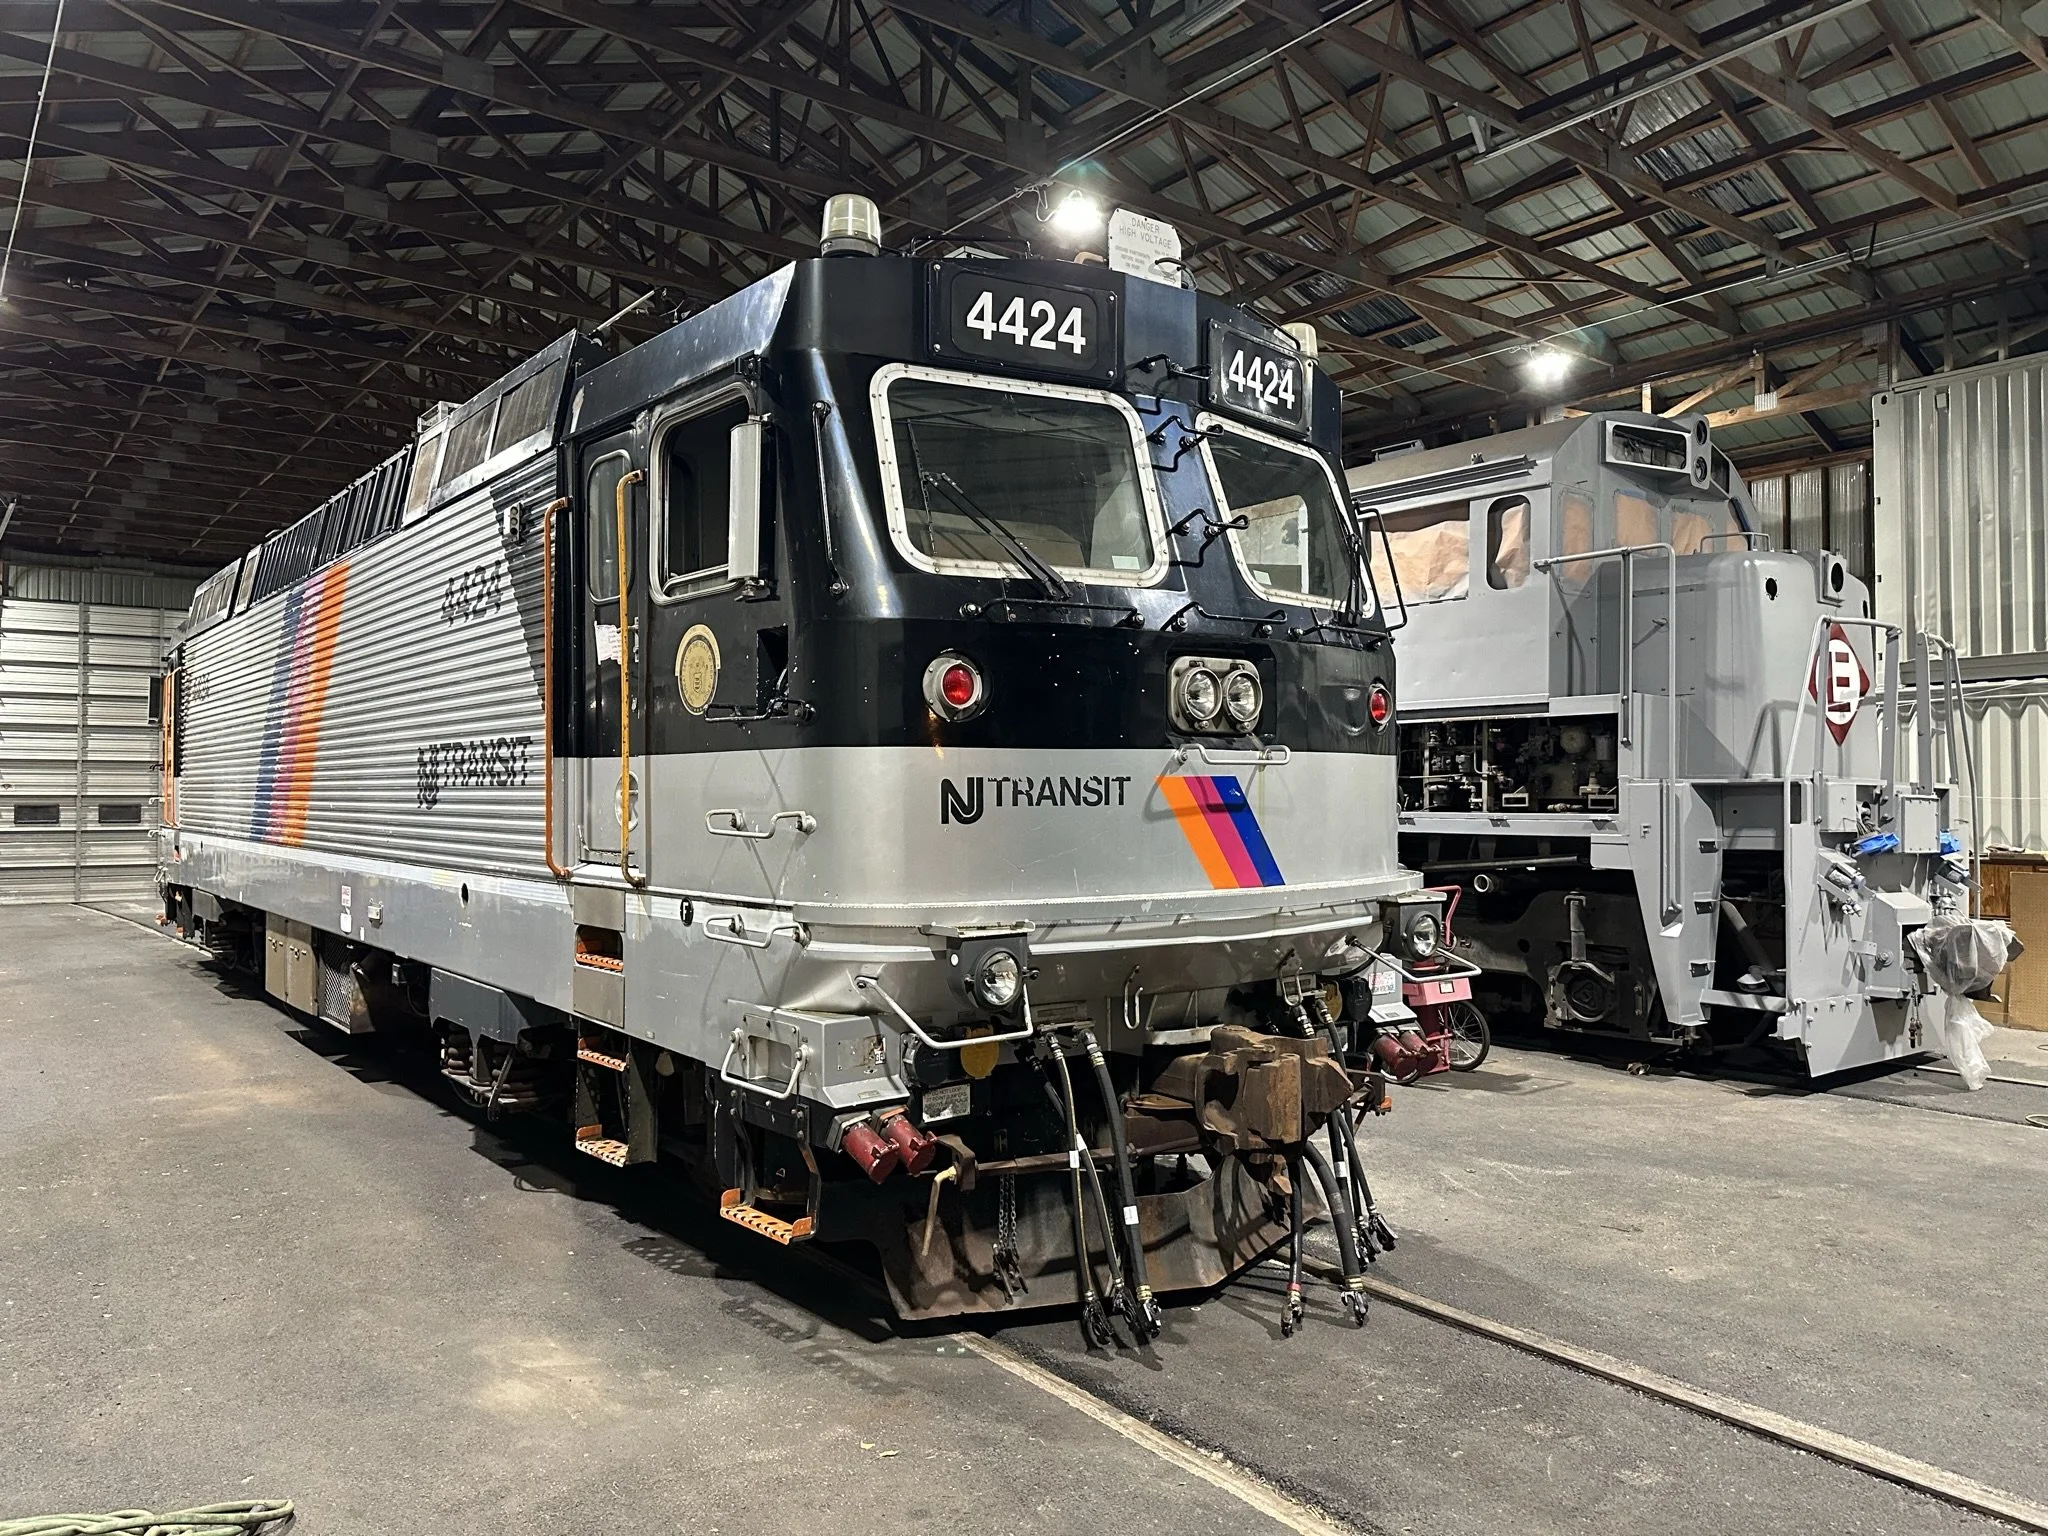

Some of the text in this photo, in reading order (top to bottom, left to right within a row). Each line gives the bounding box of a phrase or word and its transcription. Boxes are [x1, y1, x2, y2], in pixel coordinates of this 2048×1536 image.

[1119, 225, 1172, 249] HIGH VOLTAGE
[1131, 217, 1160, 233] DANGER
[966, 291, 1087, 355] 4424
[1228, 349, 1296, 410] 4424
[440, 559, 504, 627] 4424
[440, 735, 533, 787] TRANSIT
[940, 776, 1132, 825] NJ TRANSIT
[682, 901, 689, 921] F
